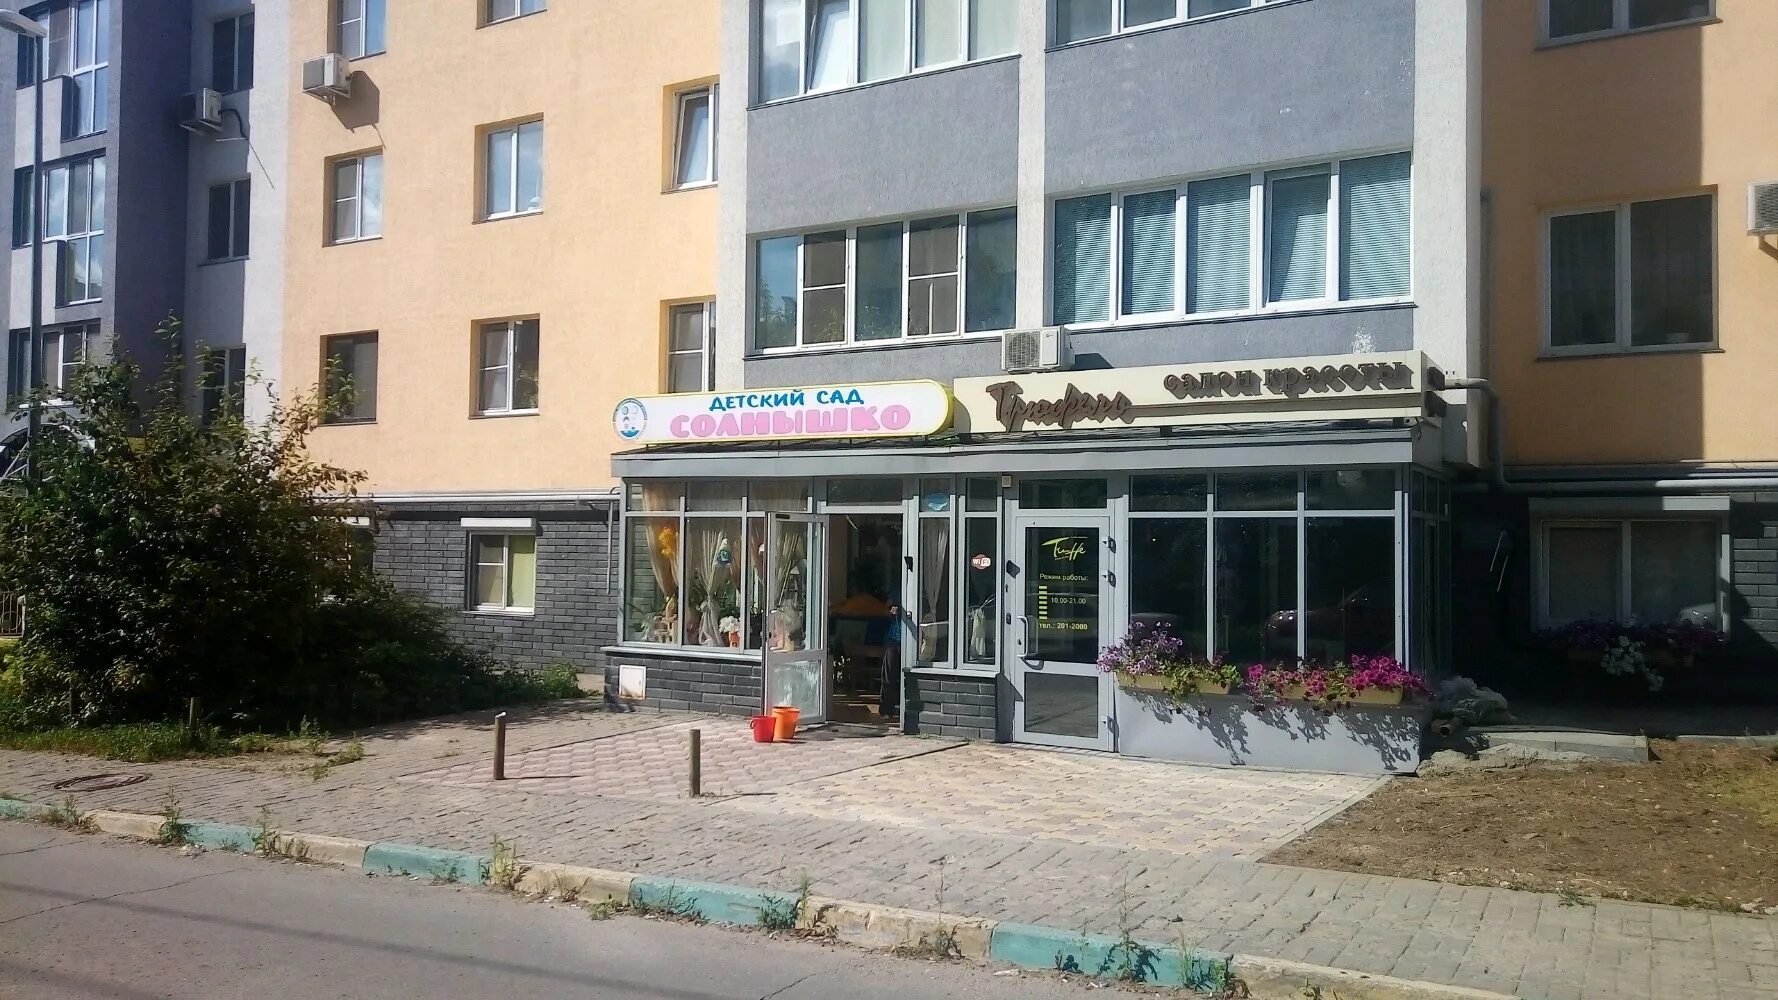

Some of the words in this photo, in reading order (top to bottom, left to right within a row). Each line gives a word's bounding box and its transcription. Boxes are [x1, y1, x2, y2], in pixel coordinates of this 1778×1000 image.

[1164, 370, 1261, 398] салон
[1263, 361, 1412, 397] красоты
[708, 389, 805, 411] ДЕТСКИЙ
[816, 388, 865, 405] САД
[669, 404, 912, 439] СОЛНЫШКО
